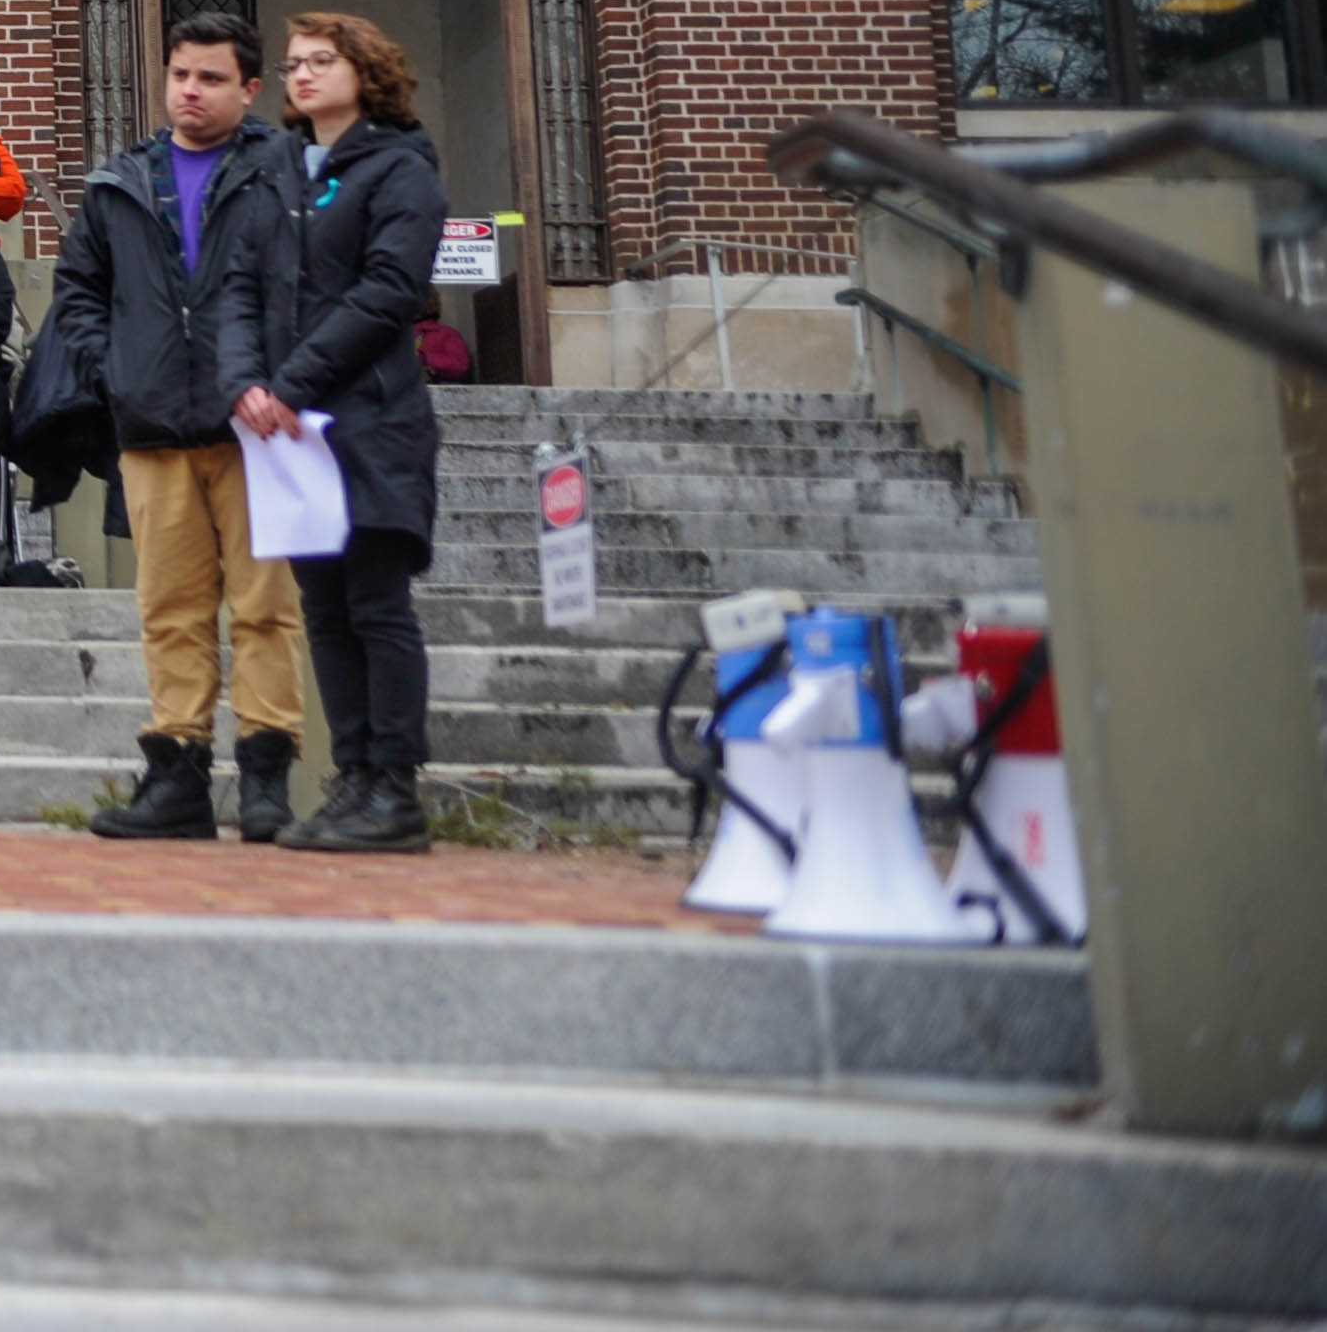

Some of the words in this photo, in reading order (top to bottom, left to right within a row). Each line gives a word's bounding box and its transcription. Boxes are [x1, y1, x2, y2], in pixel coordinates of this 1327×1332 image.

[457, 245, 493, 253] CLOSED
[442, 256, 476, 264] WINTER
[434, 268, 483, 276] NTENANCE
